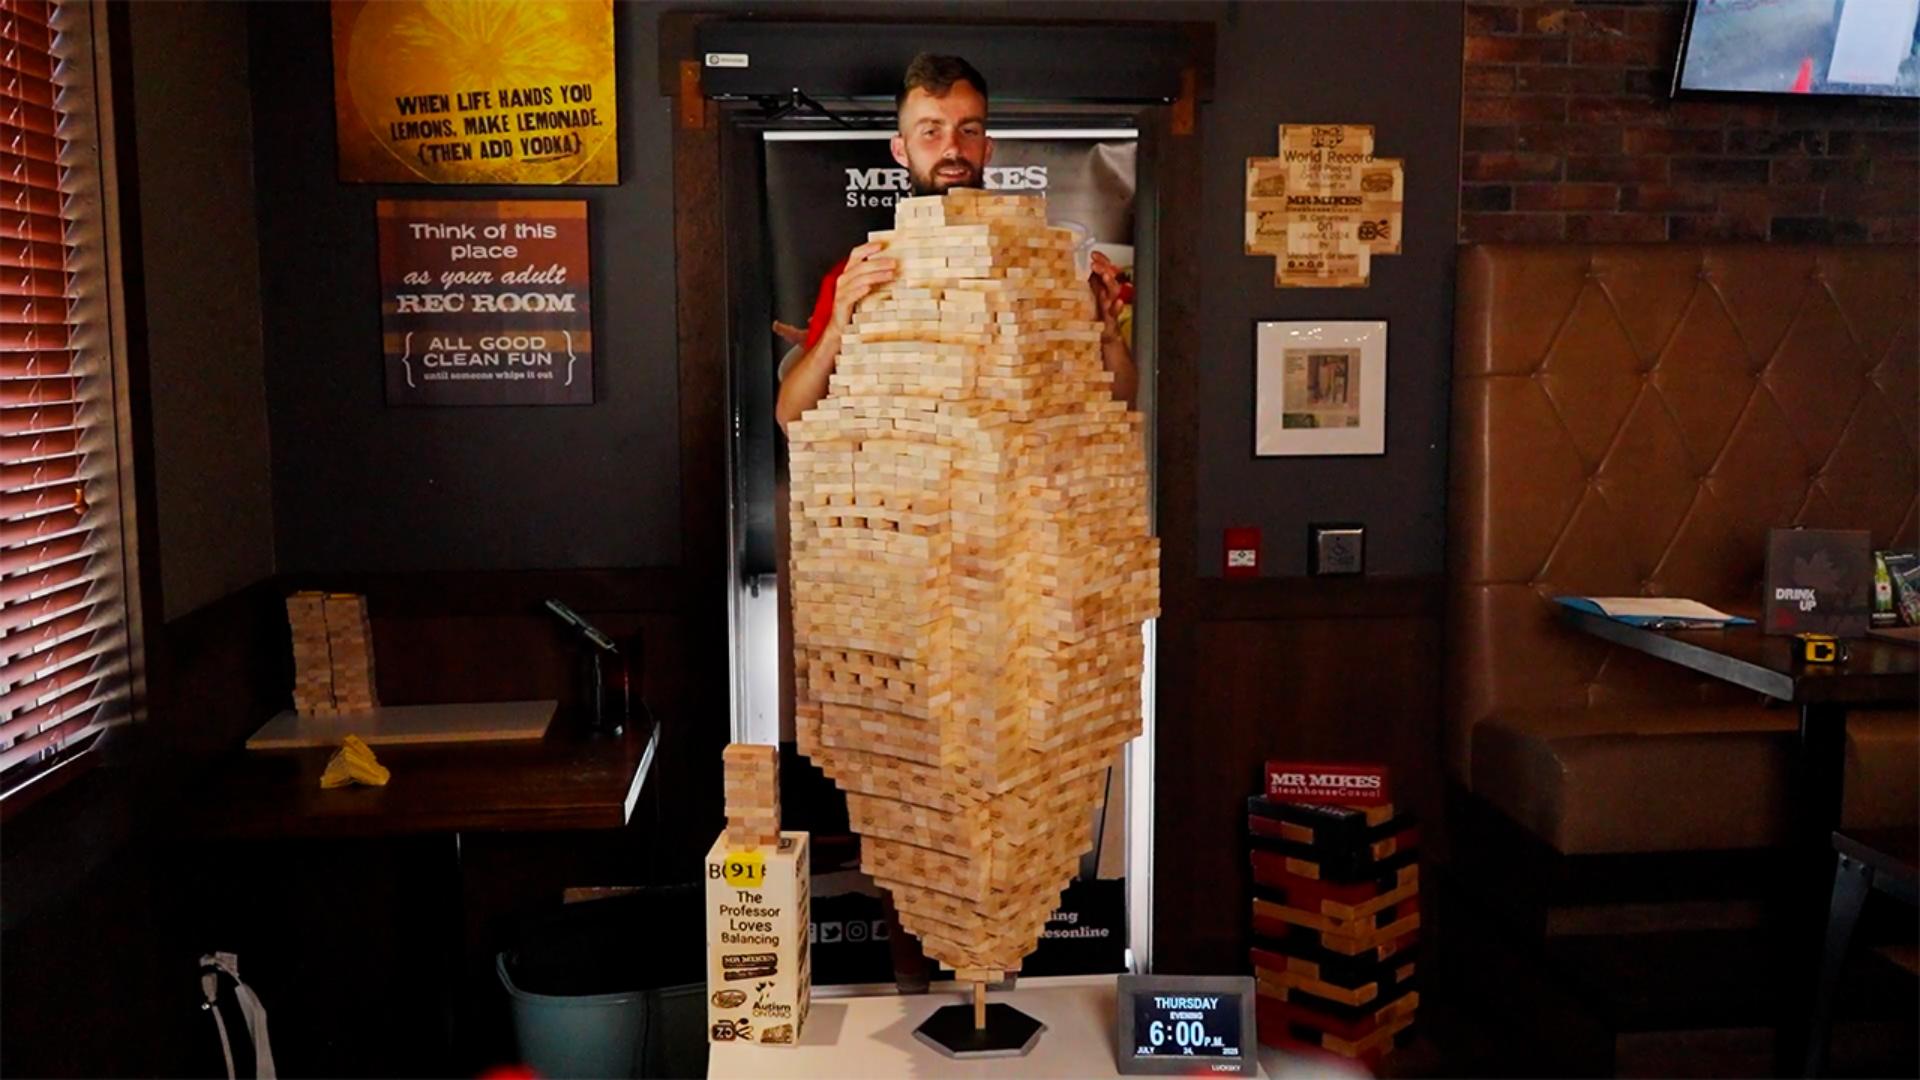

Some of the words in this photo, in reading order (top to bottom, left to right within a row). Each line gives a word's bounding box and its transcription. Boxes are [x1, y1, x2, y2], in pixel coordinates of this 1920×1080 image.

[395, 96, 450, 116] WHEN
[457, 90, 493, 112] LIFE
[499, 87, 553, 108] HANDS
[560, 83, 592, 102] YOU
[464, 114, 510, 136] MAKE
[480, 139, 514, 159] ADD
[1284, 150, 1322, 163] World
[1327, 151, 1374, 164] Record
[844, 167, 912, 190] MR
[982, 165, 1048, 190] KES
[409, 223, 476, 240] Think
[483, 223, 506, 239] of
[514, 223, 557, 240] this
[451, 244, 518, 261] place
[403, 270, 432, 285] as
[440, 270, 494, 290] your
[500, 264, 567, 284] adult
[396, 292, 465, 313] REC
[471, 292, 576, 313] ROOM
[429, 337, 472, 350] ALL
[479, 336, 546, 350] GOOD
[423, 352, 500, 367] CLEAN
[507, 352, 552, 366] FUN
[423, 371, 449, 380] until
[450, 372, 494, 380] someone
[526, 370, 535, 379] it
[536, 371, 553, 379] out
[1775, 587, 1815, 600] DRINK
[1800, 600, 1817, 611] UP
[1270, 773, 1306, 786] MR
[1308, 774, 1381, 788] MIKES
[730, 863, 755, 879] 91
[736, 890, 763, 903] The
[719, 904, 781, 917] Professor
[729, 918, 773, 932] Loves
[721, 932, 780, 948] Balancing
[752, 1001, 792, 1012] Autism
[1154, 997, 1219, 1010] THURSDAY
[1169, 1011, 1204, 1020] EVENING
[1149, 1020, 1204, 1047] 6:00
